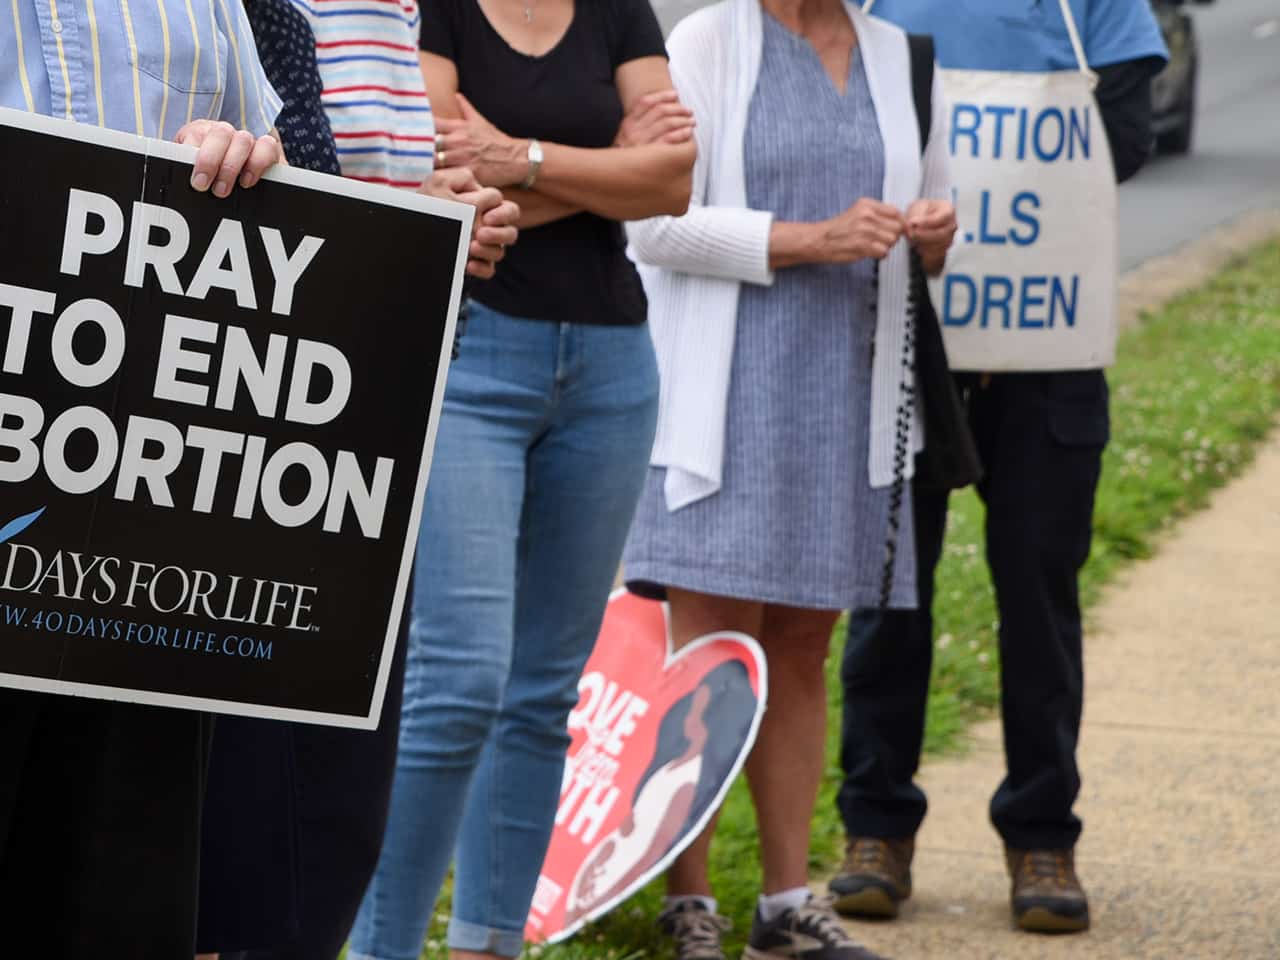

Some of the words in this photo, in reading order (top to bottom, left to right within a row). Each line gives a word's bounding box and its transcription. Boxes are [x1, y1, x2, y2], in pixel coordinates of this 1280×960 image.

[949, 103, 1090, 162] RTION
[60, 188, 325, 316] PRAY
[941, 272, 1079, 330] DREN
[153, 314, 352, 426] END
[566, 670, 650, 757] OVE
